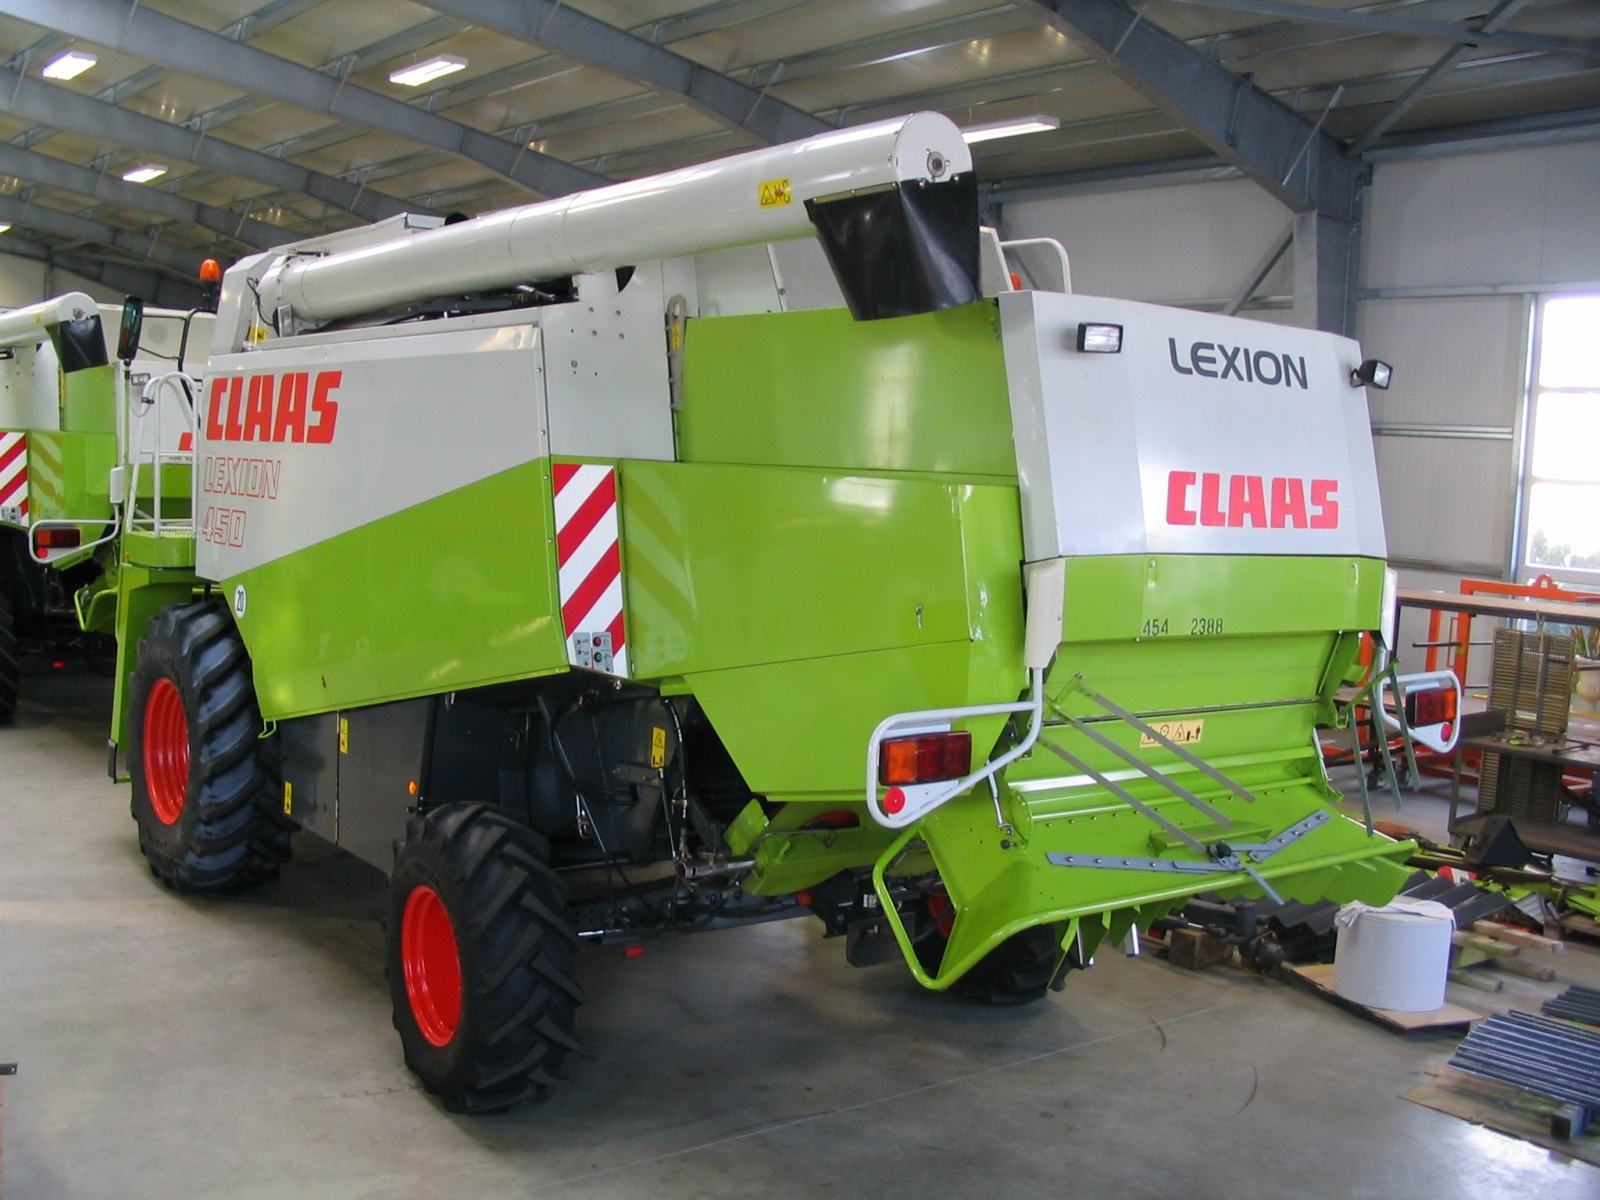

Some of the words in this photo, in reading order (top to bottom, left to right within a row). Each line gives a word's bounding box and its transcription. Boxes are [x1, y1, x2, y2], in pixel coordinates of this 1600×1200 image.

[1168, 337, 1308, 389] LEXION
[205, 370, 342, 444] CLAAS
[203, 456, 281, 499] LEXION
[1165, 470, 1339, 530] CLAAS
[202, 506, 246, 548] 450
[236, 589, 244, 612] 20
[1142, 618, 1169, 636] 454
[1190, 617, 1224, 636] 2388
